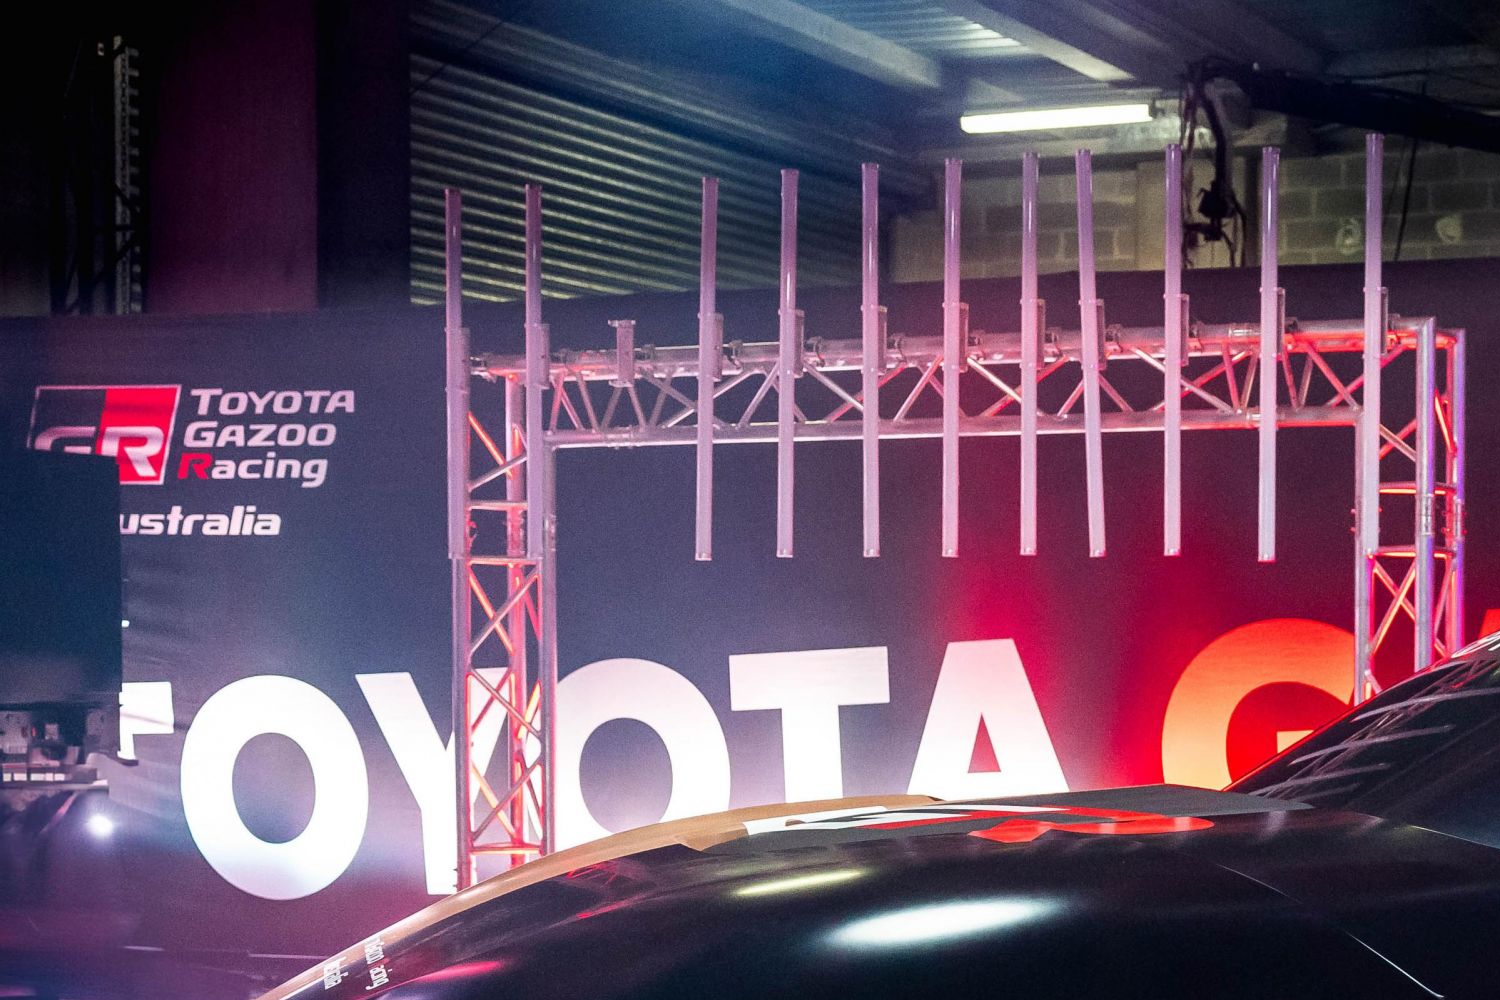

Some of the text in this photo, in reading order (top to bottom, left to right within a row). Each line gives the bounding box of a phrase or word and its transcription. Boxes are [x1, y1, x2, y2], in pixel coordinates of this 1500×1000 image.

[189, 387, 356, 416] TOYOTA
[182, 420, 338, 448] GAZOO
[176, 451, 329, 488] Racing
[119, 505, 282, 536] ustralia
[118, 638, 1071, 900] OYOTA
